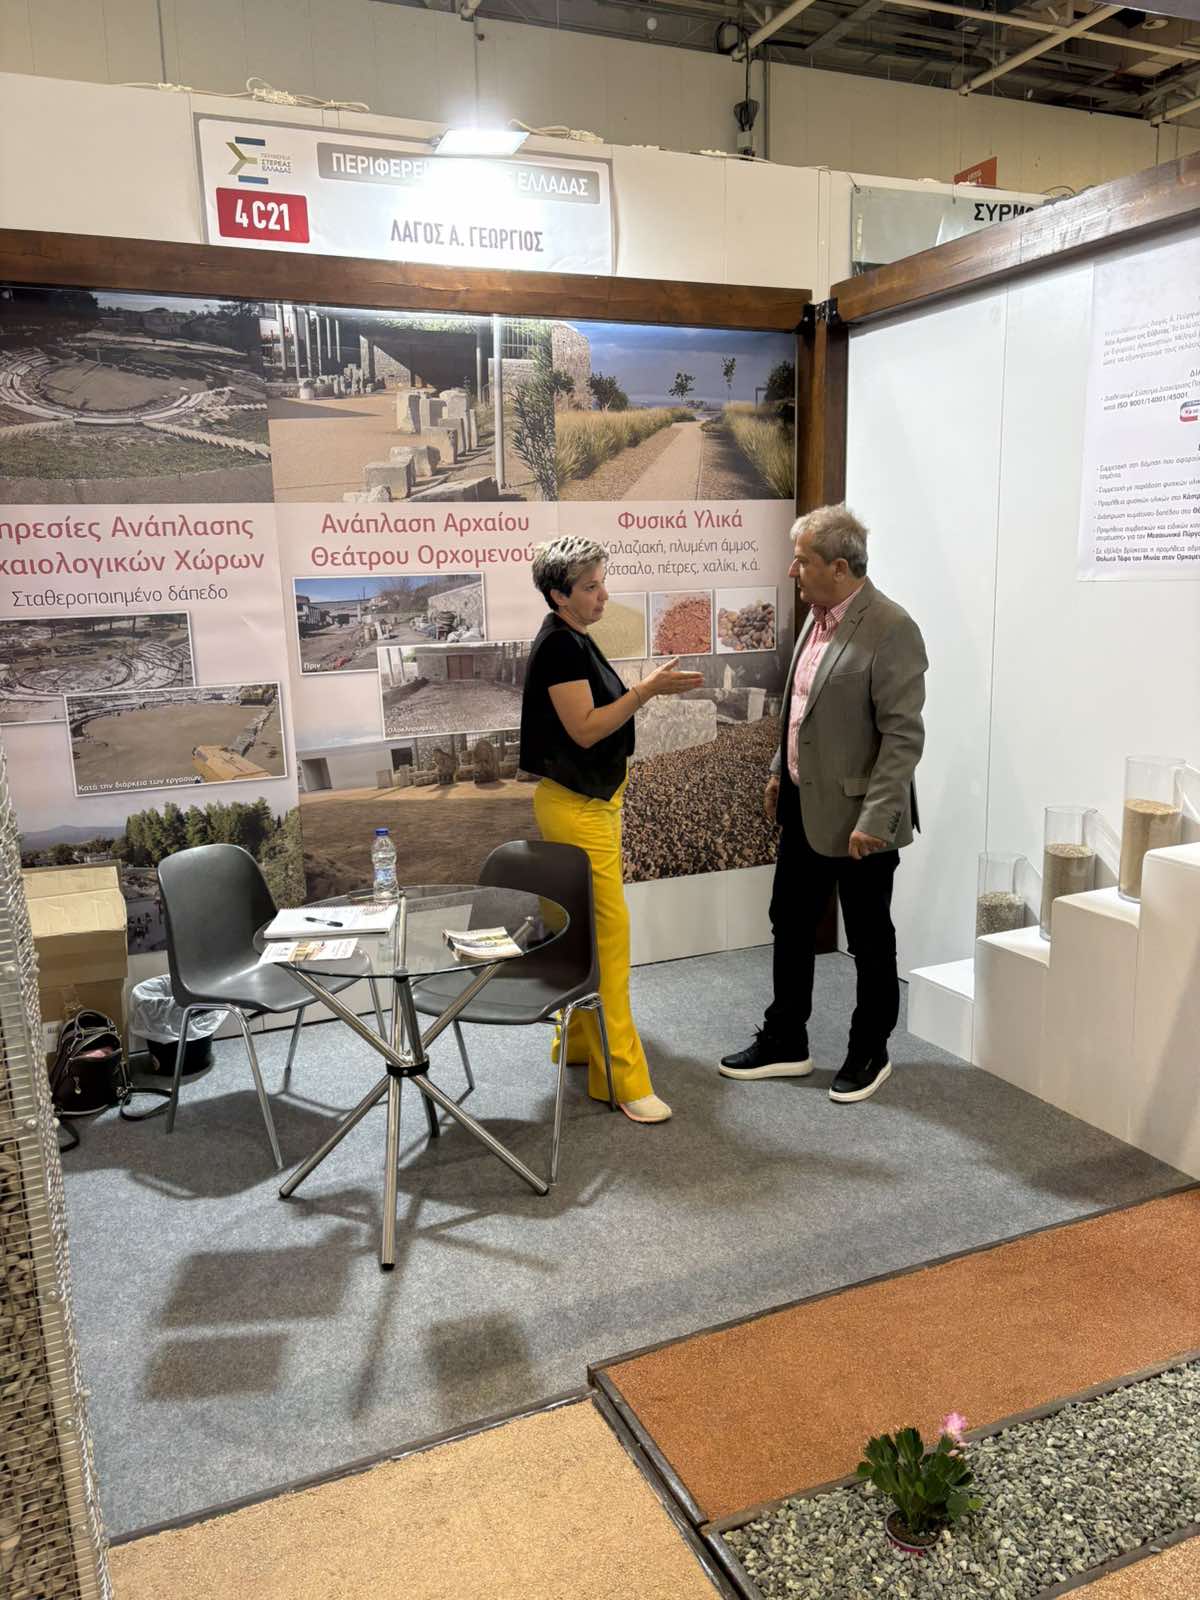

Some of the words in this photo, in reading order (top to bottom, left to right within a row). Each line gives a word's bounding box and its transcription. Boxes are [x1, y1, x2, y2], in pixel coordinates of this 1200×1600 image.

[519, 172, 589, 196] ΕΛΛΑΔΑΣ
[390, 219, 444, 245] ΛΑΓΟΣ
[449, 225, 465, 247] Α.
[470, 226, 544, 252] ΓΕΩΡΓΙΟΣ
[111, 515, 254, 539] Ανάπλασης
[321, 512, 436, 534] Ανάπλαση
[443, 511, 530, 537] Αρχαίου
[618, 510, 687, 530] Φυσικά
[693, 508, 743, 529] Υλικά
[311, 544, 409, 570] Θεάτρου
[417, 542, 535, 569] Ορχομενού
[669, 539, 718, 556] πλυμένη
[721, 539, 759, 554] άμμος,
[175, 548, 265, 576] Χώρων
[657, 560, 700, 577] πέτρες,
[702, 558, 739, 573] χαλίκι,
[741, 558, 761, 572] κ.ά.
[11, 586, 163, 609] Σταθεροποιημένο
[168, 584, 228, 602] δάπεδο
[304, 662, 320, 671] Πριν
